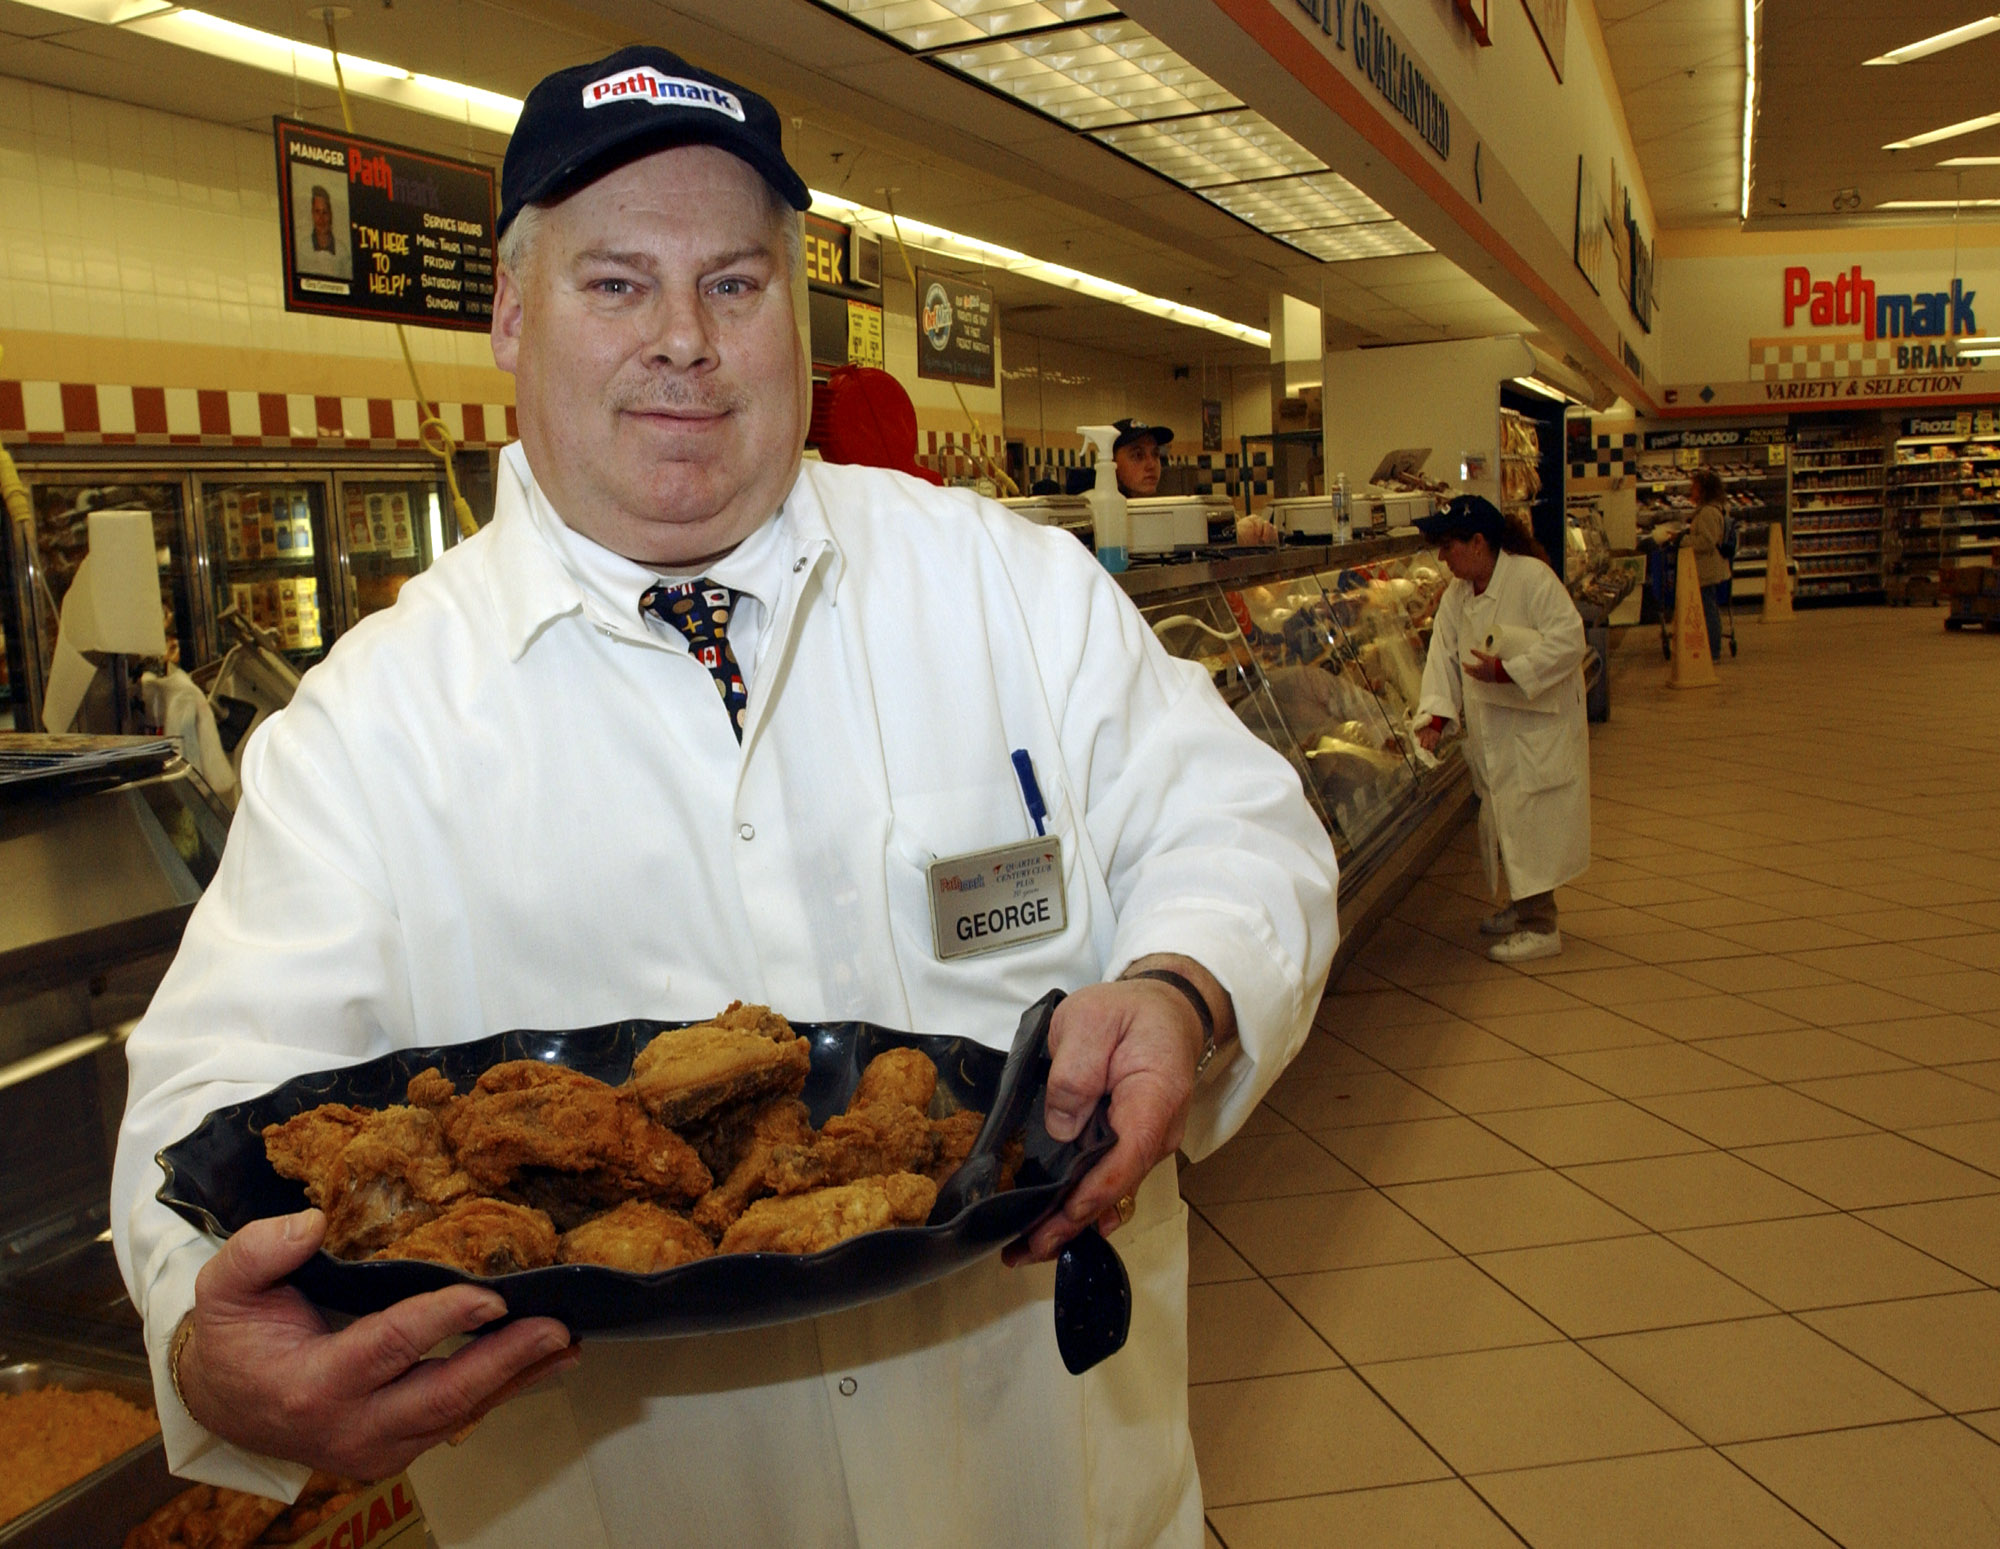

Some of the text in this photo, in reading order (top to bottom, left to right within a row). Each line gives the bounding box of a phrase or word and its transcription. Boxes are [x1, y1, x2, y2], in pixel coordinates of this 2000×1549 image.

[593, 73, 731, 109] Pathmark
[290, 141, 345, 166] MANAGER
[383, 231, 410, 256] HERE
[372, 252, 391, 274] TO
[423, 255, 456, 270] FRIDAY
[805, 234, 843, 284] EEK
[421, 273, 462, 292] SATURDAY
[426, 294, 460, 312] SUNDAY
[1784, 265, 1977, 341] Pathmark
[1765, 375, 1964, 400] VARIETY & SELECTION
[1681, 431, 1740, 446] SEAFOOD
[1911, 418, 1957, 434] FROZE
[996, 869, 1031, 883] CENTURY
[957, 897, 1051, 941] GEORGE
[310, 1482, 413, 1549] CIAL
